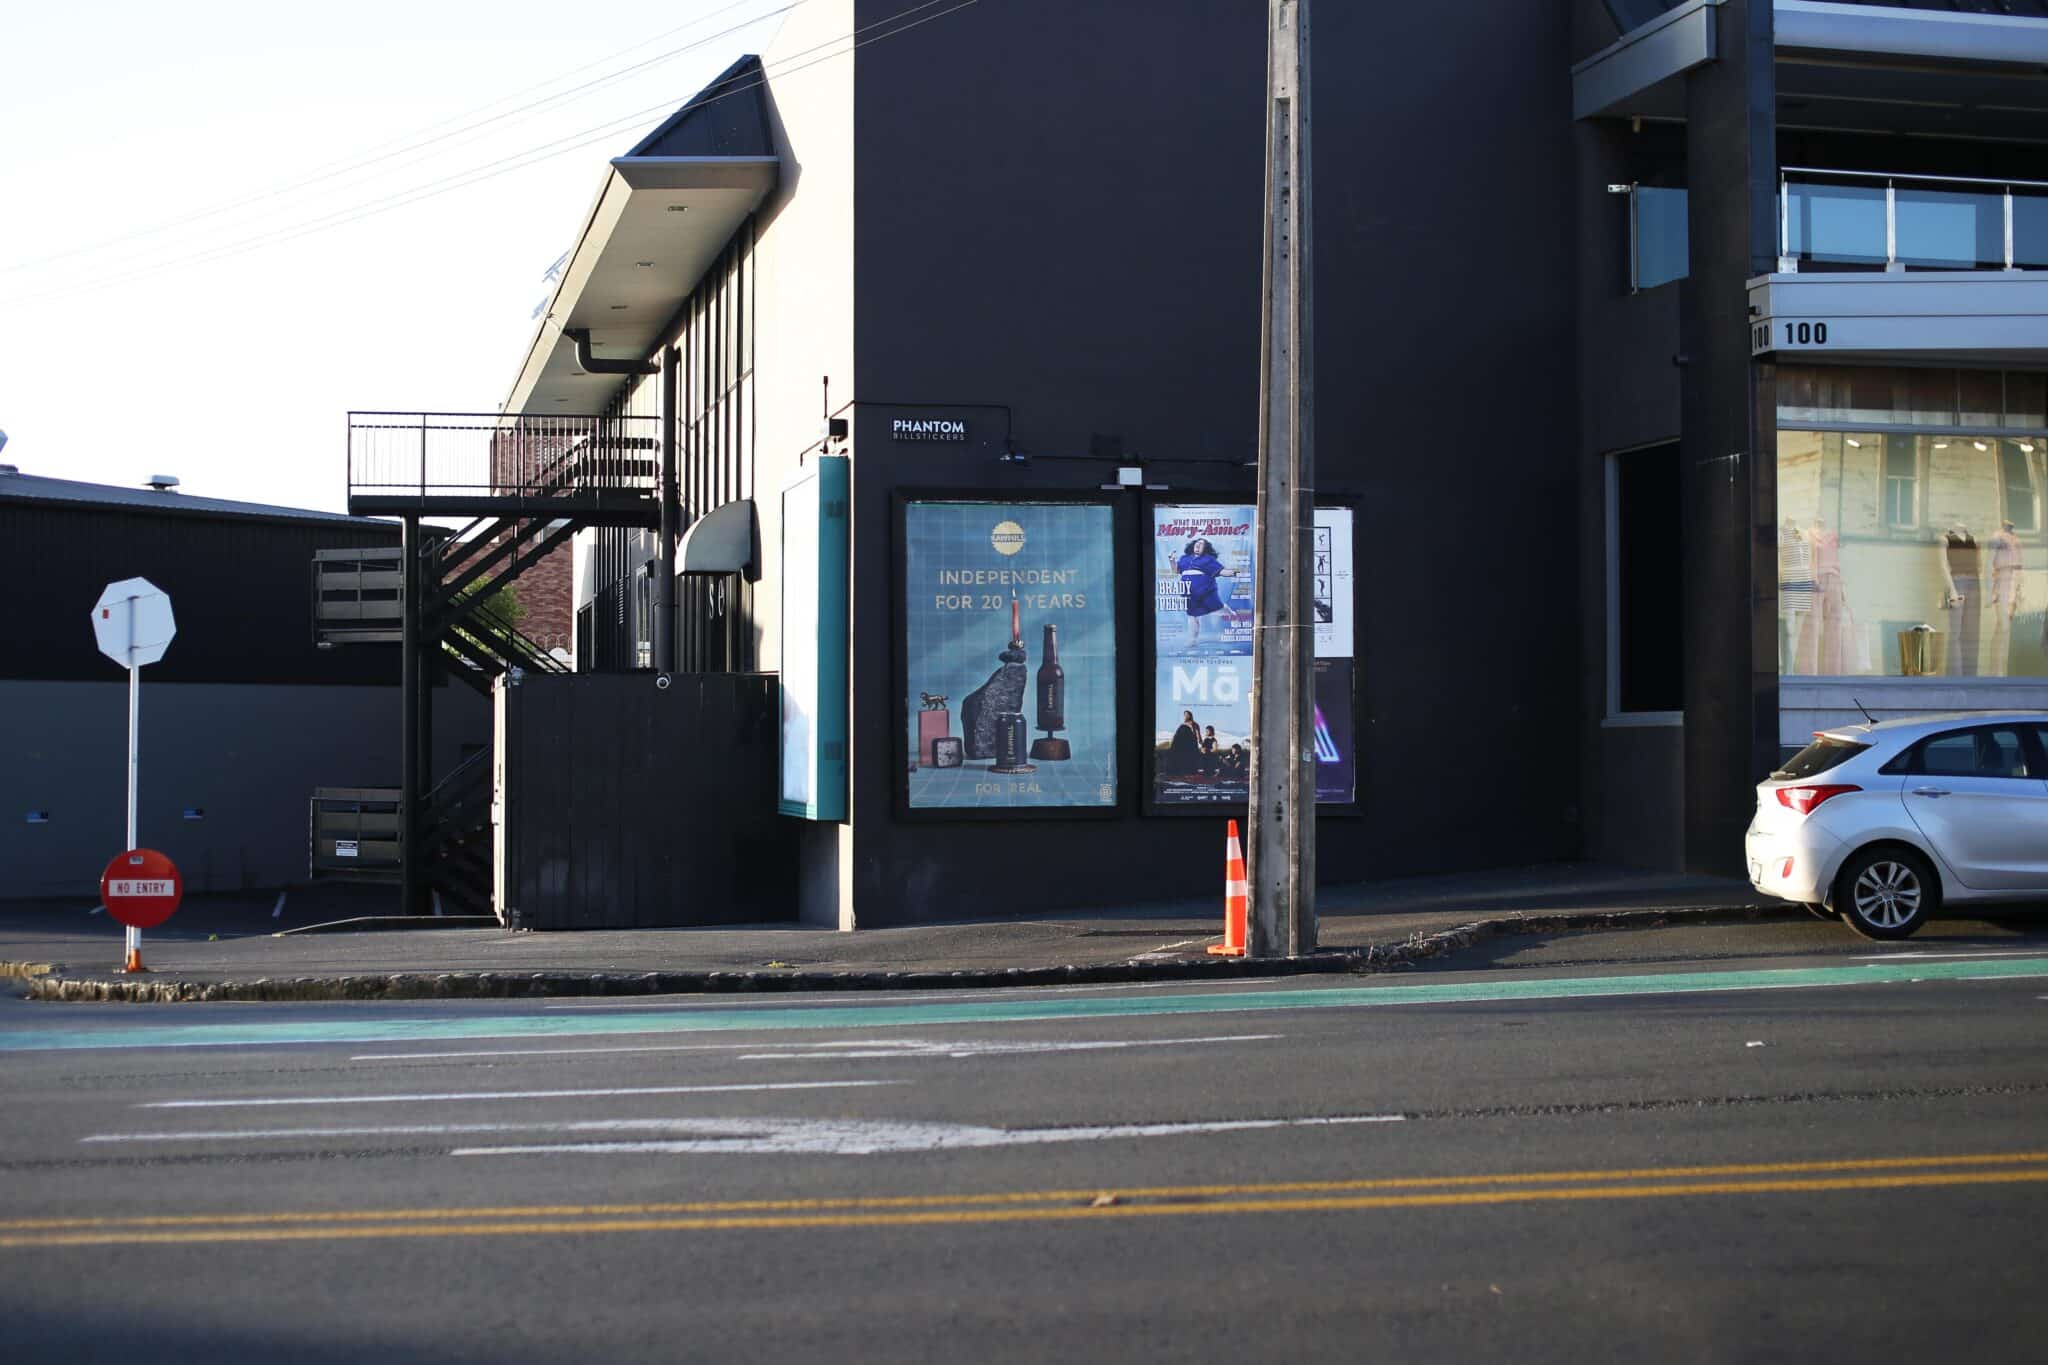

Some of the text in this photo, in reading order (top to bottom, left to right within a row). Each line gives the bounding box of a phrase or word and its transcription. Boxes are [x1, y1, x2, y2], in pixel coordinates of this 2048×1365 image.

[1785, 322, 1827, 345] 100
[893, 419, 965, 433] PHANTOM
[893, 432, 965, 441] BILLSTICKERS
[939, 569, 1079, 585] INDEPENDENT
[1159, 580, 1192, 595] BRADY
[935, 593, 1086, 609] FOR 20 YEARS
[975, 782, 1043, 794] FOR REAL
[117, 882, 166, 894] NO ENTRY
